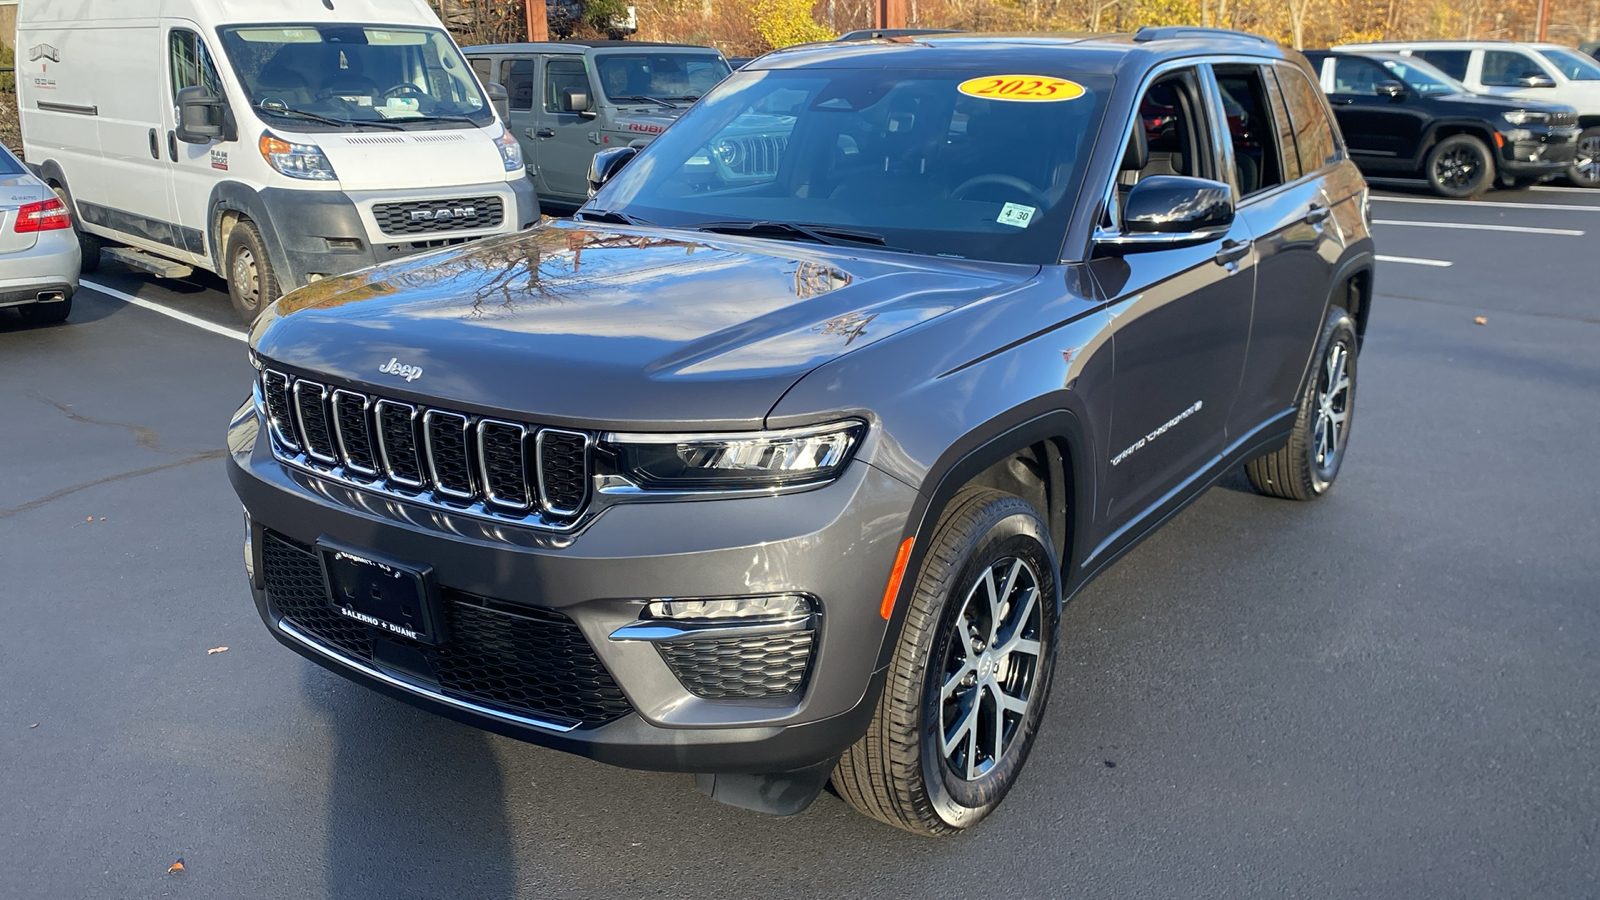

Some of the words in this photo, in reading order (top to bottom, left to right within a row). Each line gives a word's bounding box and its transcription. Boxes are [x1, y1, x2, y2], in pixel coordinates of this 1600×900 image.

[976, 79, 1066, 97] 2025
[628, 123, 663, 134] RUBI
[410, 207, 476, 221] RAM
[1005, 209, 1013, 217] 4
[1016, 211, 1029, 221] 30
[378, 357, 423, 383] Jeep
[341, 607, 379, 626] SALERNO
[389, 623, 417, 640] DUANE
